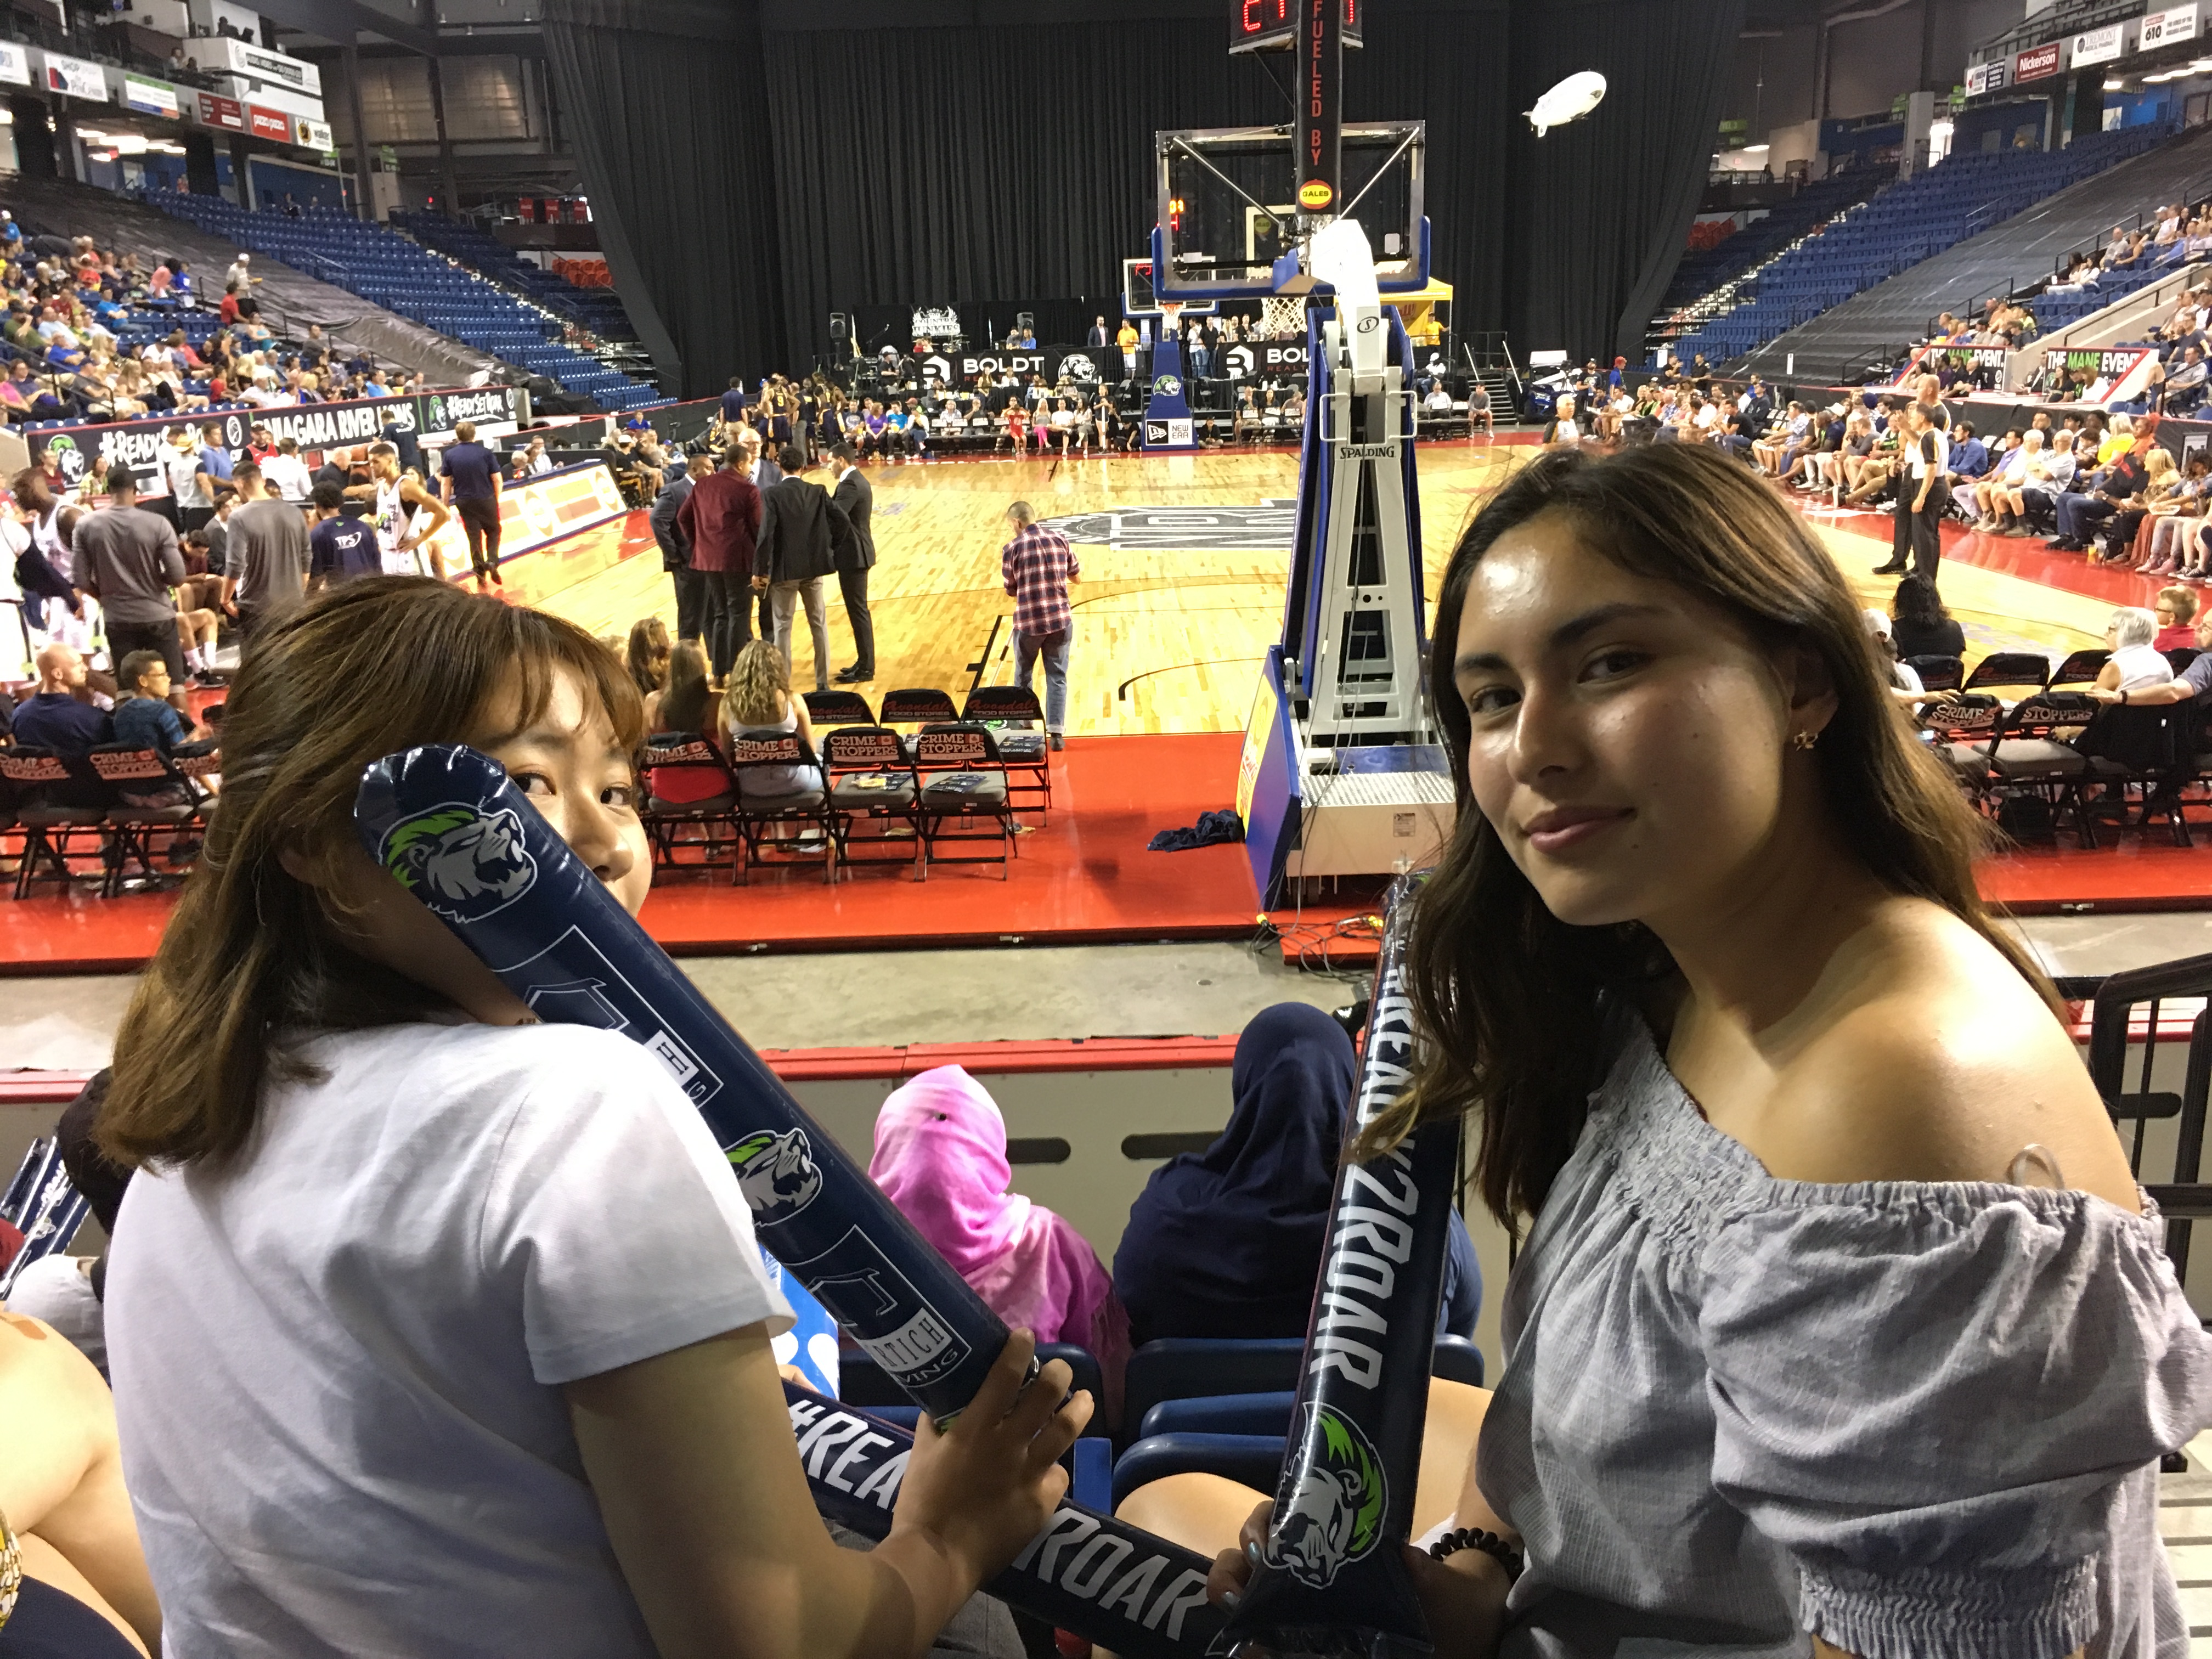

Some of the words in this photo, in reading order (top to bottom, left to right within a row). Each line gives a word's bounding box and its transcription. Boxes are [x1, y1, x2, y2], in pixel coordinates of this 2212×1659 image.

[2086, 28, 2117, 46] TREMONT
[2146, 25, 2162, 41] 610
[1312, 0, 1323, 117] FUELED
[2019, 53, 2056, 72] Nickerson
[1311, 129, 1321, 166] BY
[963, 357, 1045, 373] BOLDT
[2047, 351, 2067, 369] THE
[2068, 352, 2101, 371] MANE
[263, 411, 338, 446] NIAGARA
[337, 407, 380, 439] RIVER
[1340, 445, 1395, 459] SPALDING
[335, 534, 356, 548] TPS
[1936, 704, 1984, 719] CRIME
[2023, 706, 2094, 720] STOPPERS
[830, 736, 876, 746] CRIME
[919, 733, 964, 743] CRIME
[736, 740, 779, 752] CRIME
[831, 746, 898, 756] STOPPERS
[919, 742, 985, 753] STOPPERS
